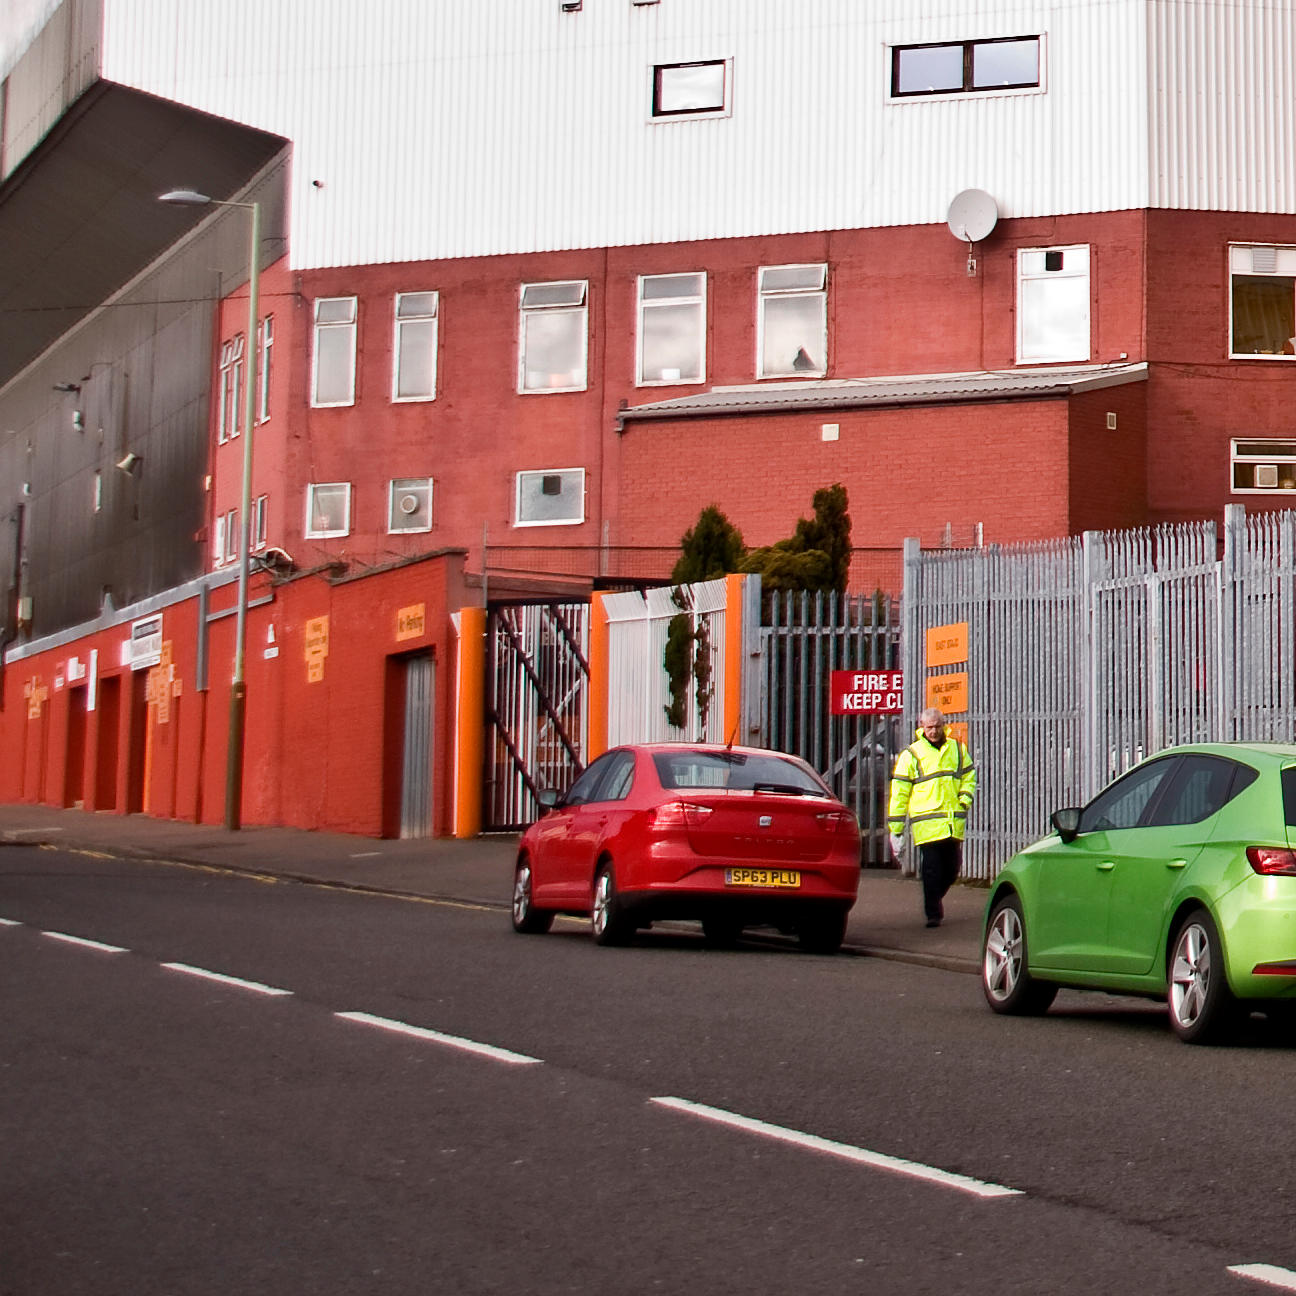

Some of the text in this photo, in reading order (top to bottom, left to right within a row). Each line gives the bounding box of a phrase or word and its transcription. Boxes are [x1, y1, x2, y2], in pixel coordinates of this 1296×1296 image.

[853, 674, 888, 691] FIRE
[843, 693, 881, 710] KEEP
[733, 870, 797, 884] SP63 PLU
